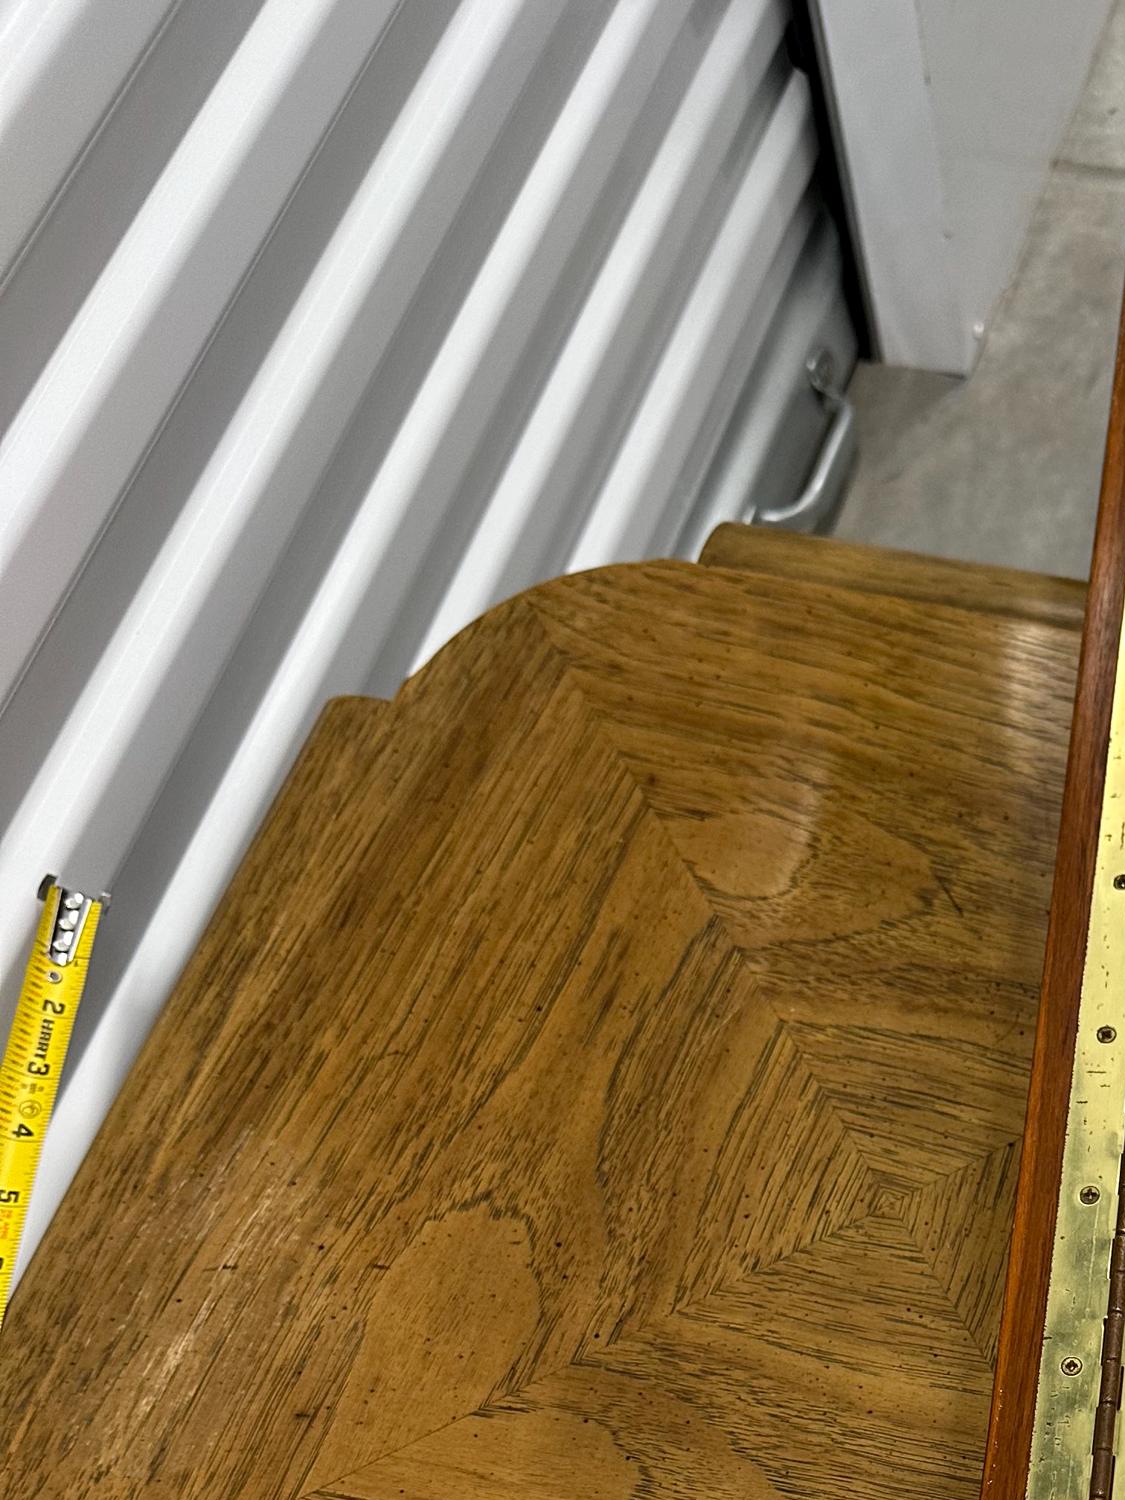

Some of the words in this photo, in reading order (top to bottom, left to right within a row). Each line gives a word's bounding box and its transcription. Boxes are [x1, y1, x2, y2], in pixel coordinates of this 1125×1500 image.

[42, 999, 66, 1015] 2
[34, 1018, 55, 1061] HART
[27, 1061, 51, 1077] 3
[11, 1123, 35, 1138] 4
[0, 1190, 20, 1204] 5
